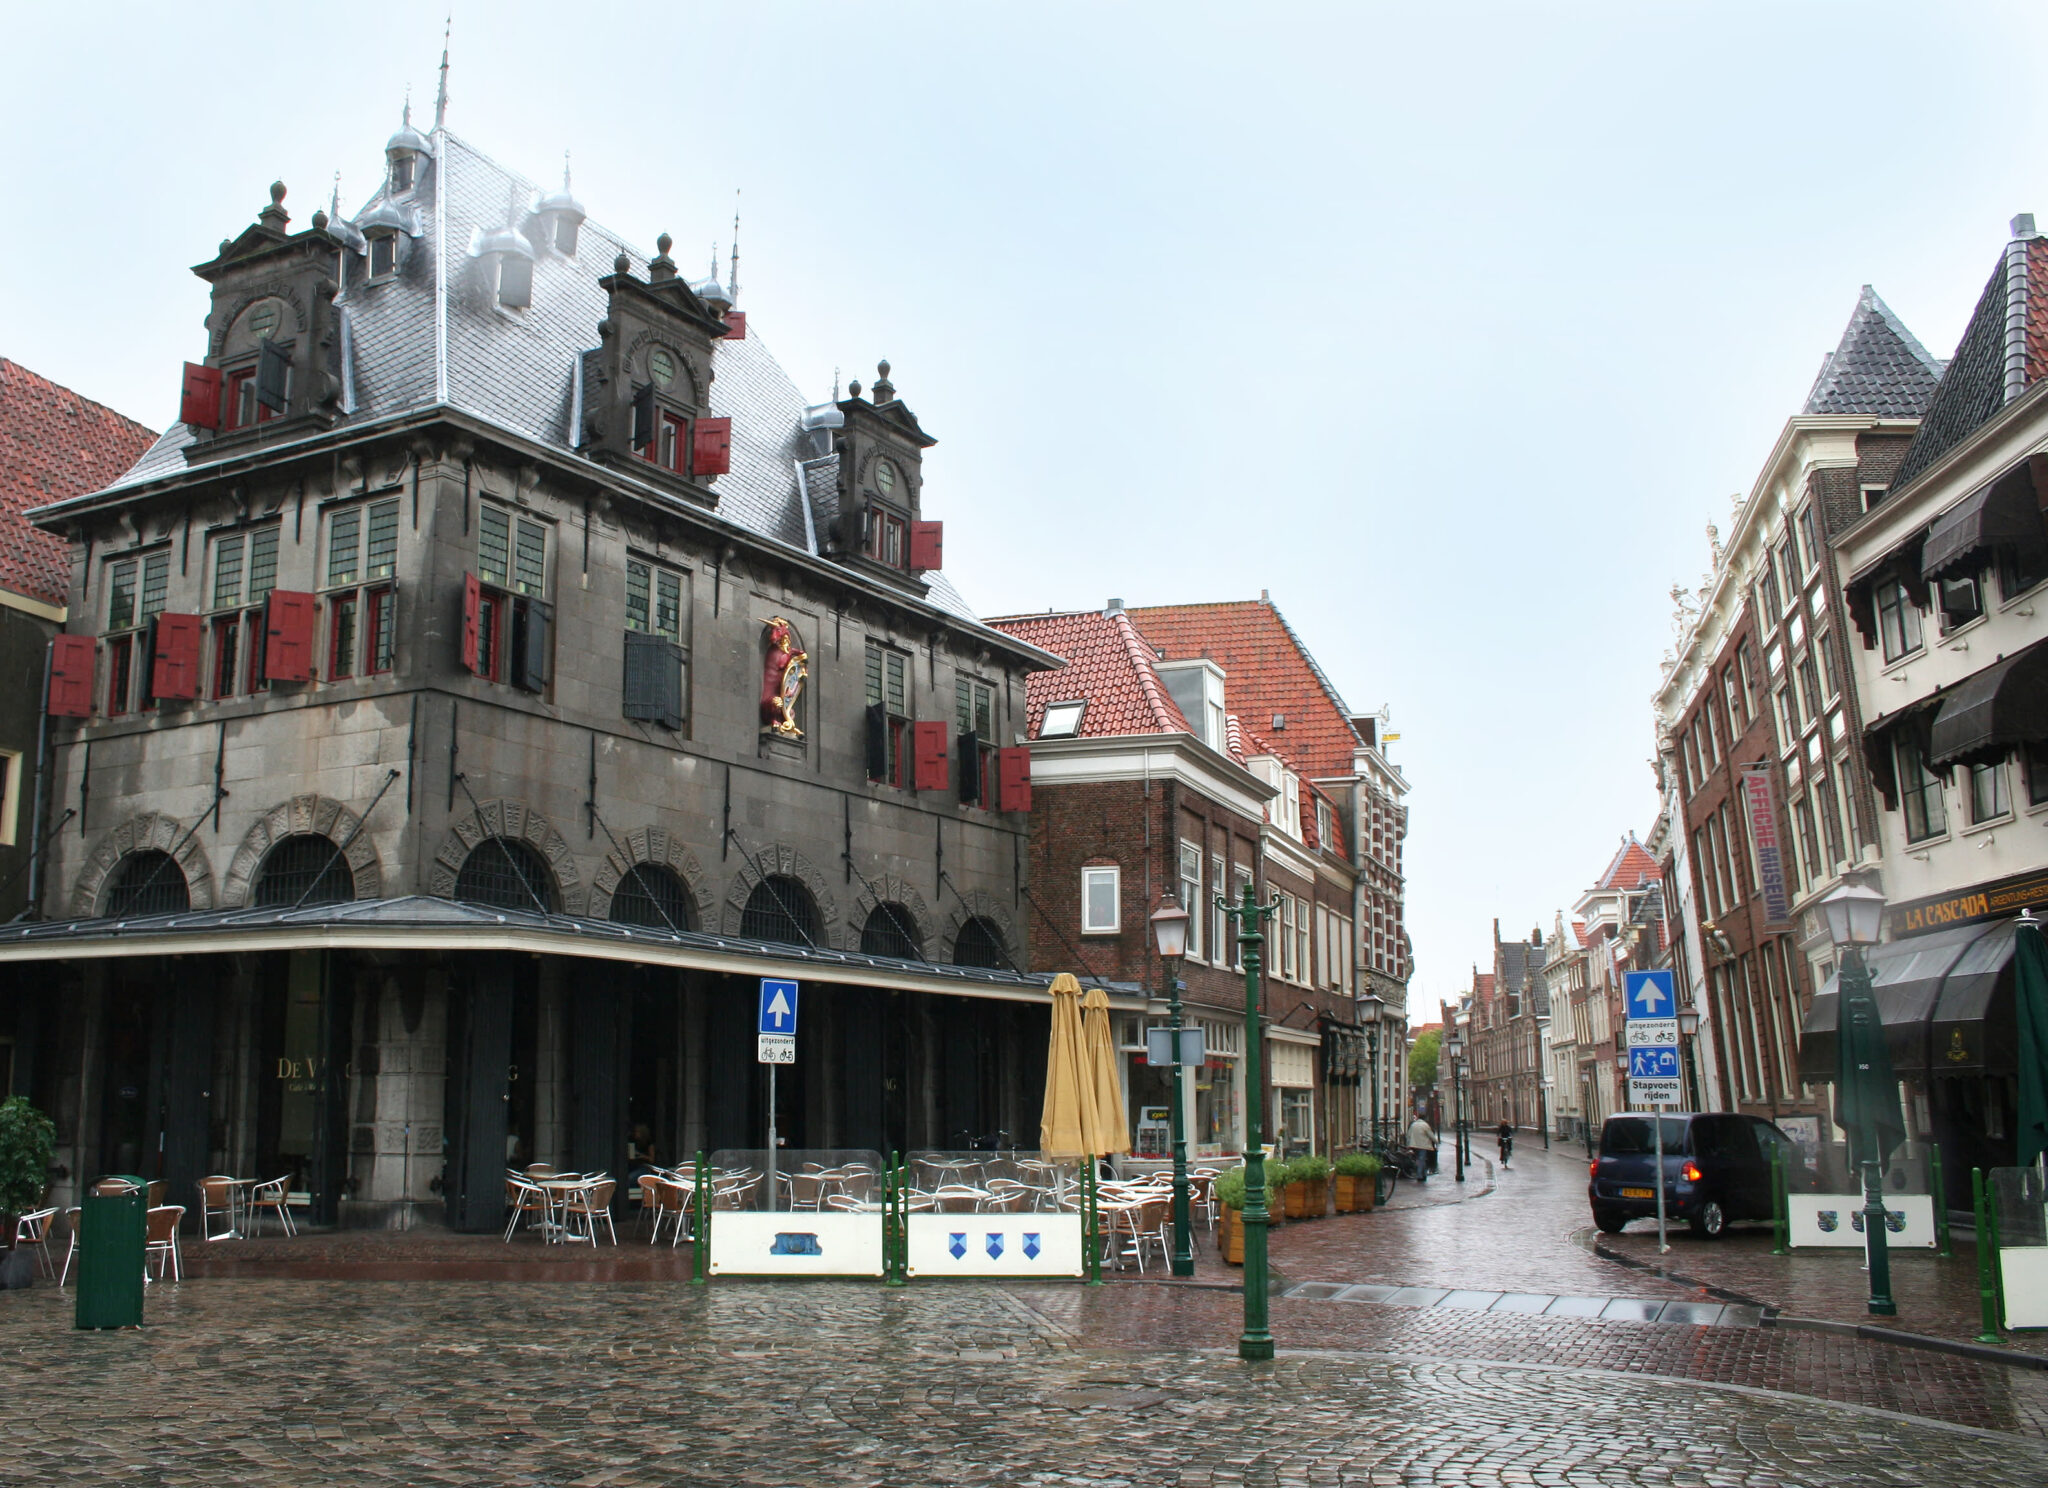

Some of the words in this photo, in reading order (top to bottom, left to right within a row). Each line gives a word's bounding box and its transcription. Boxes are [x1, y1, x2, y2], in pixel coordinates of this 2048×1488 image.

[1906, 909, 1924, 930] LA
[1925, 893, 1990, 926] CASCADA
[761, 1037, 794, 1045] uitgezonderd
[1632, 1081, 1678, 1090] Stapvoets
[1644, 1091, 1670, 1100] rijden
